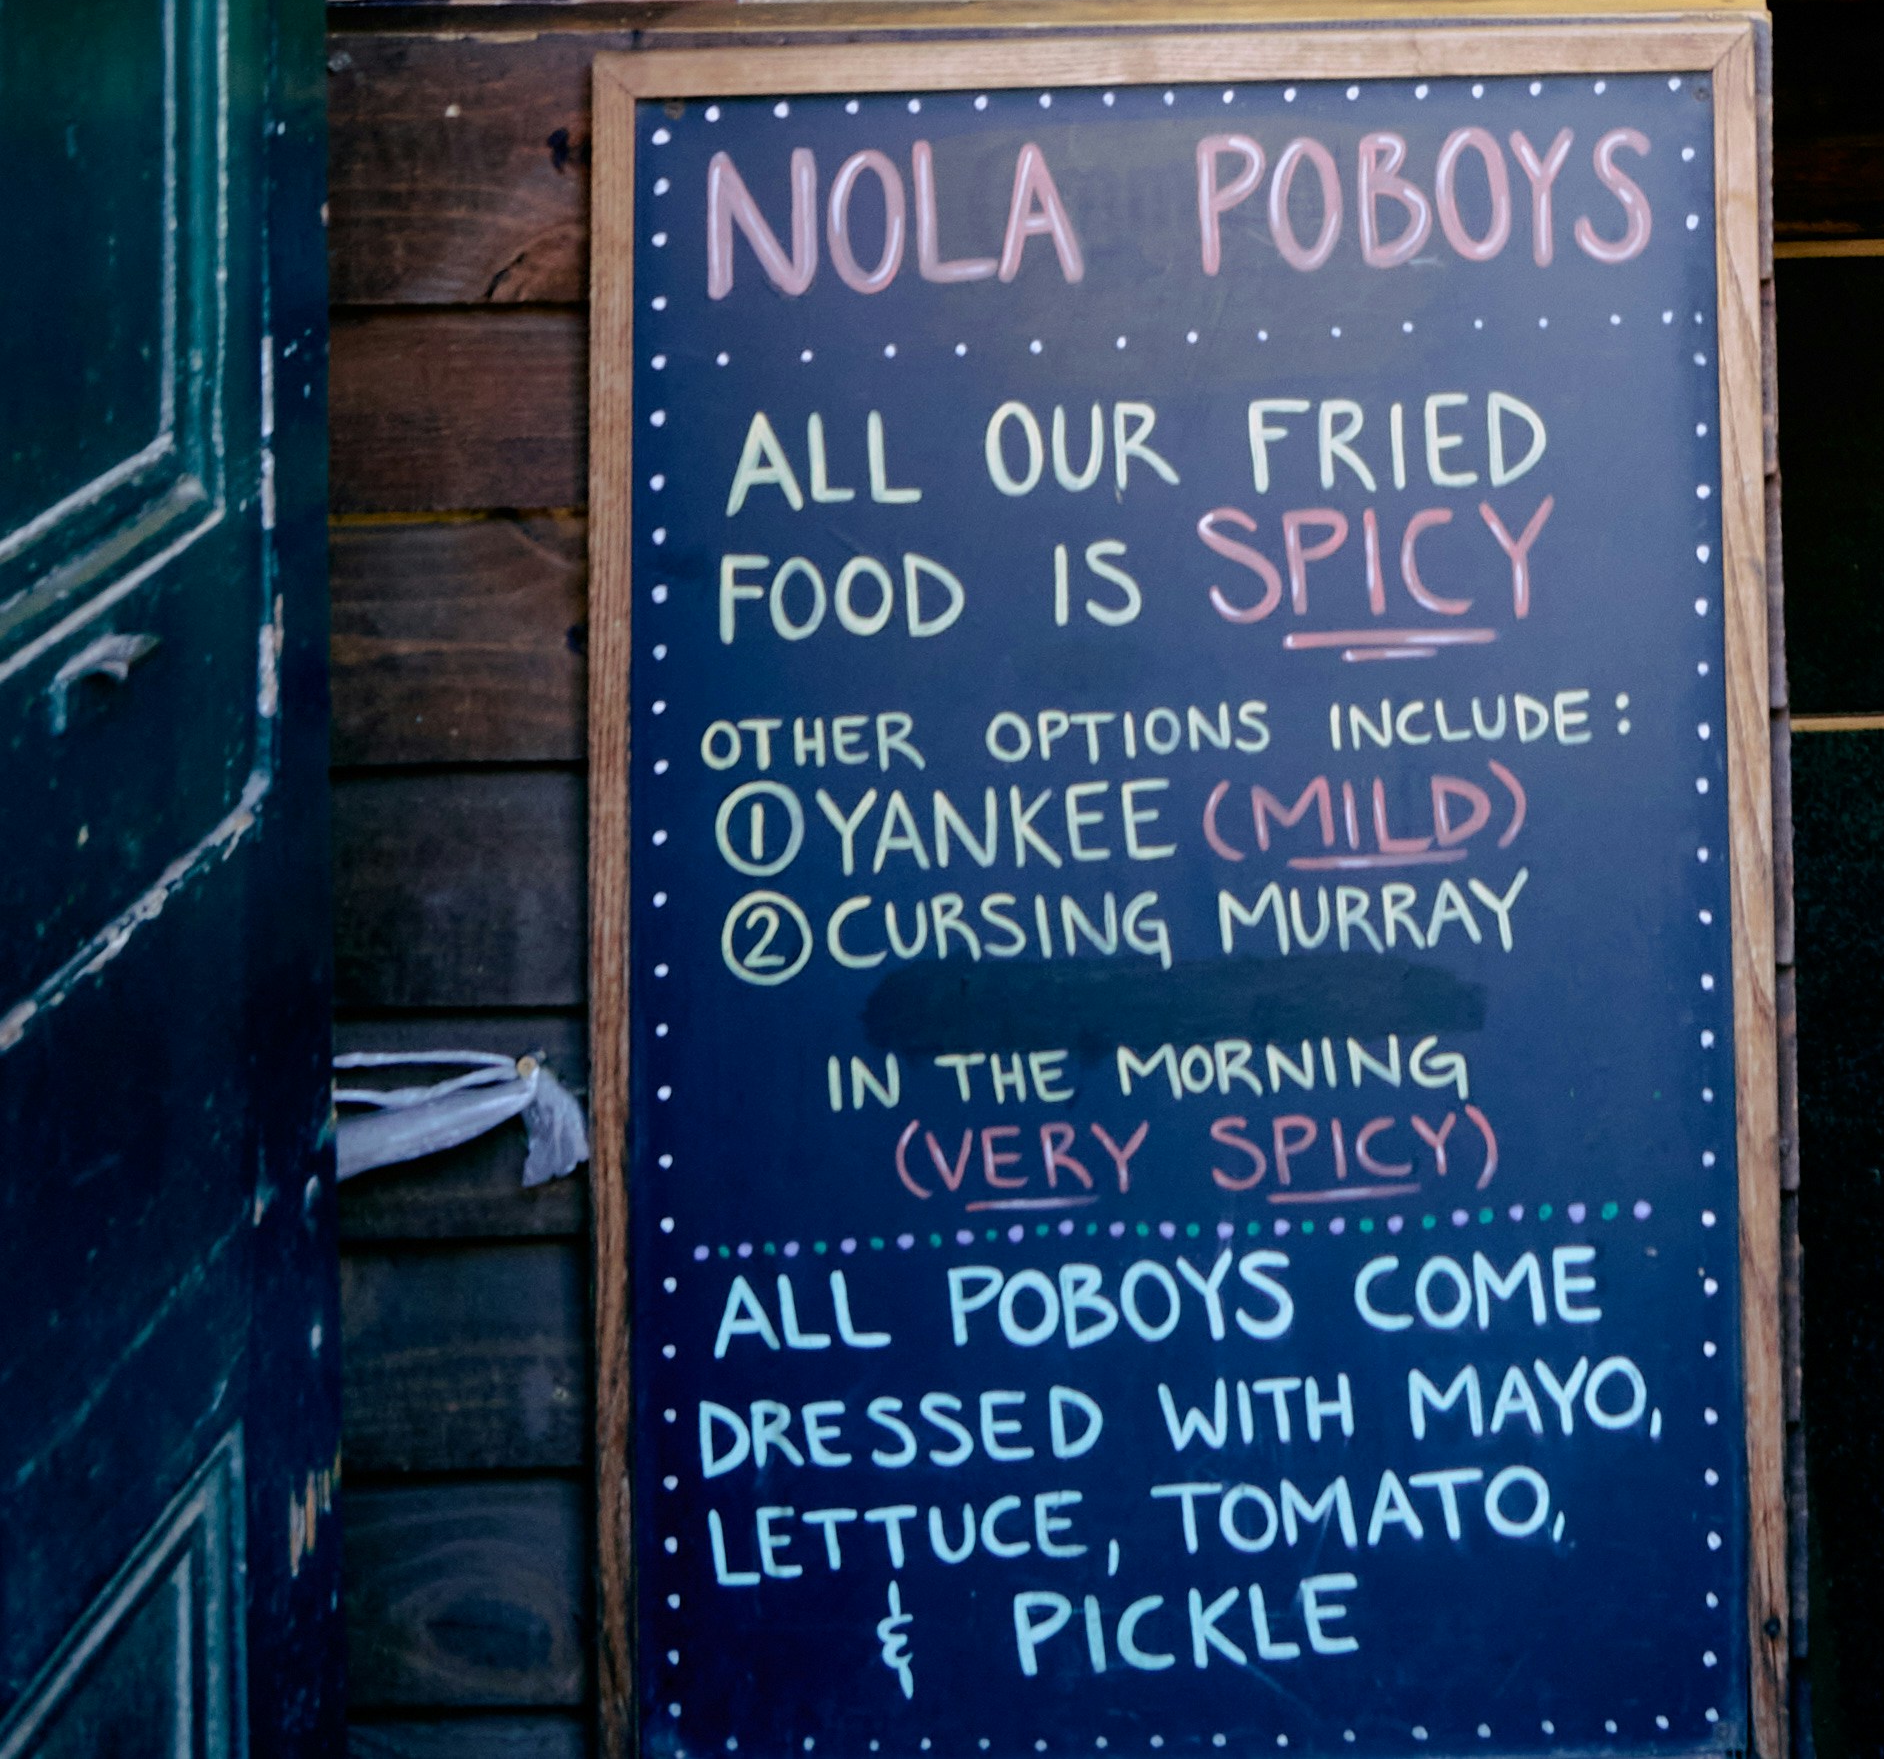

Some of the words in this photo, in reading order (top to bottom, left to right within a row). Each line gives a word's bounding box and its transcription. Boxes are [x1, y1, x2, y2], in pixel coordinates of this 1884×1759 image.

[707, 140, 1084, 300] NOLA
[1198, 128, 1652, 277] POBOYS
[727, 410, 921, 517] ALL
[984, 400, 1179, 497] OUR
[1248, 392, 1546, 493] FRIED
[719, 552, 965, 644] FOOD
[1055, 539, 1143, 626] IS
[1199, 497, 1554, 623] SPICY
[701, 712, 926, 772] OTHER
[986, 700, 1271, 764] OPTIONS
[817, 777, 1176, 874] YANKEE
[1202, 760, 1529, 863] (MILD)
[826, 891, 1172, 969] CURSING
[1220, 869, 1529, 954] MURRAY
[828, 1052, 901, 1111] IN
[935, 1048, 1075, 1103] THE
[1117, 1034, 1471, 1101] MORNING
[896, 1118, 1149, 1199] (VERY
[1211, 1105, 1500, 1190] SPICY)
[715, 1267, 892, 1358] ALL
[949, 1249, 1294, 1347] POBOYS
[1355, 1246, 1604, 1333] COME
[699, 1387, 1102, 1479] DRESSED
[1158, 1372, 1355, 1454] WITH
[1409, 1354, 1663, 1441] MAYO,
[707, 1488, 1121, 1586] LETTUCE,
[1151, 1465, 1566, 1557] TOMATO,
[1014, 1573, 1359, 1676] PICKLE
